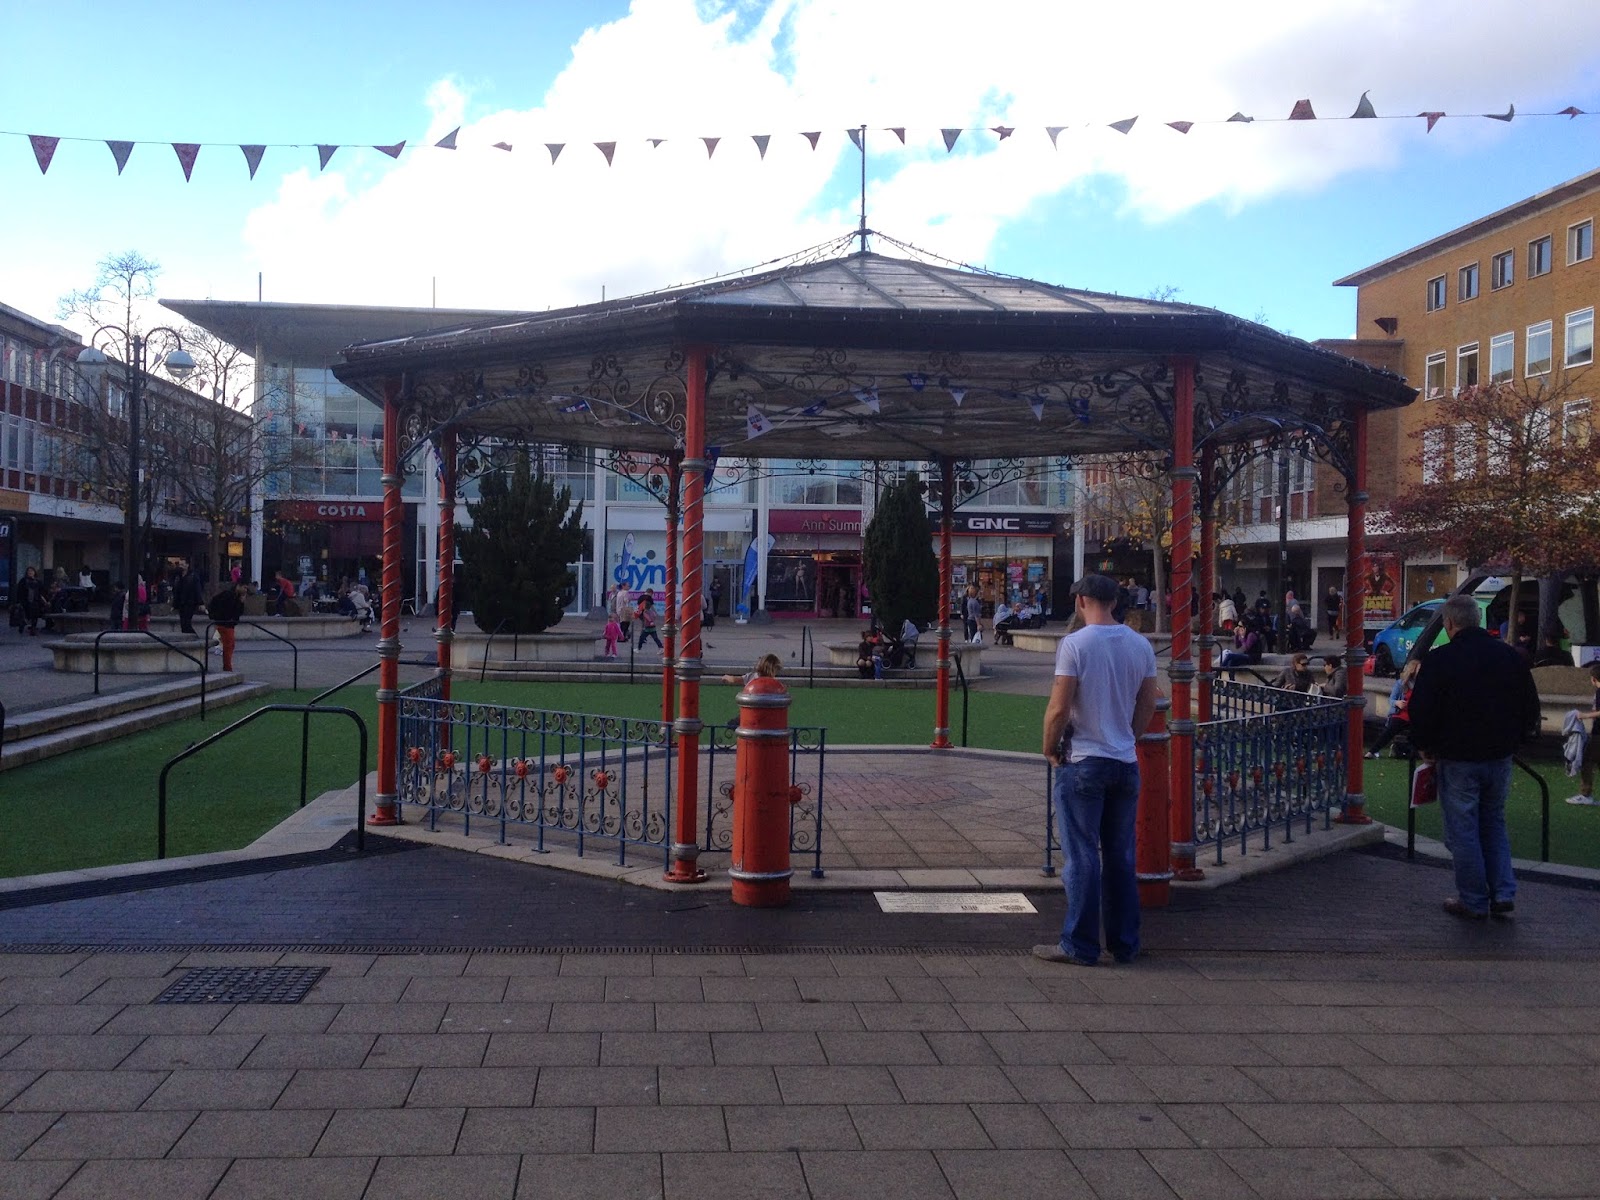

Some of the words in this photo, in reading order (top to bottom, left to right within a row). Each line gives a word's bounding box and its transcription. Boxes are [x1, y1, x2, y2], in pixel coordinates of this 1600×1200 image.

[317, 505, 366, 517] COSTA
[802, 519, 825, 531] Ann
[829, 519, 862, 531] Summ
[968, 518, 1020, 530] GNC
[614, 564, 679, 591] gym
[1406, 640, 1416, 651] Sk
